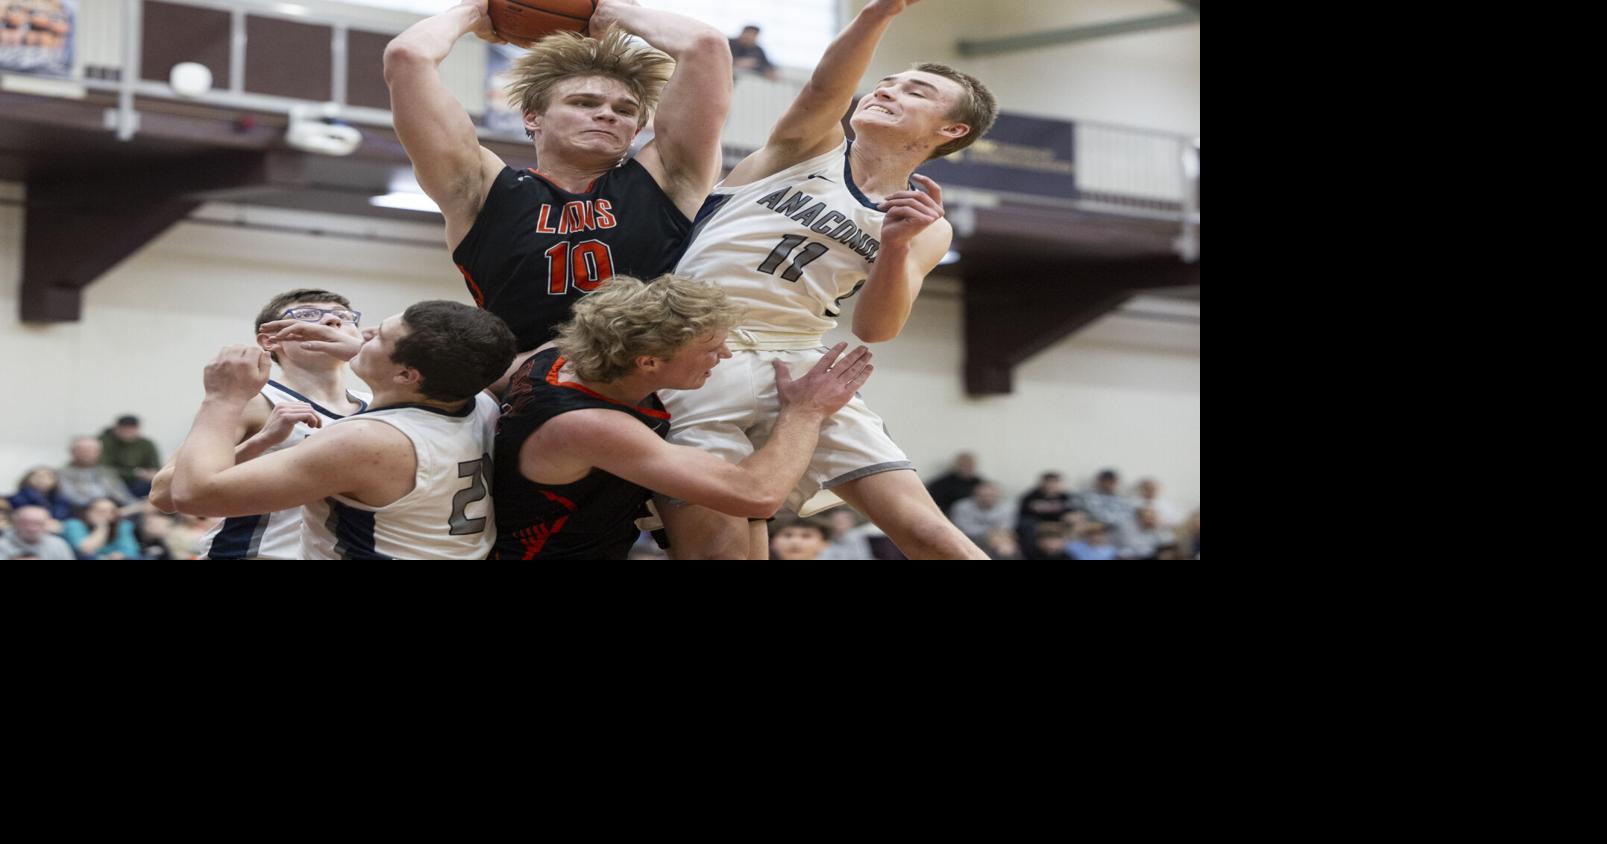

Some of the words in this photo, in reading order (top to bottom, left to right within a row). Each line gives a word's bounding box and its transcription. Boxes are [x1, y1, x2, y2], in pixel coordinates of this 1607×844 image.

[756, 186, 881, 263] ANACOND
[544, 239, 616, 295] 10
[757, 233, 830, 283] 11
